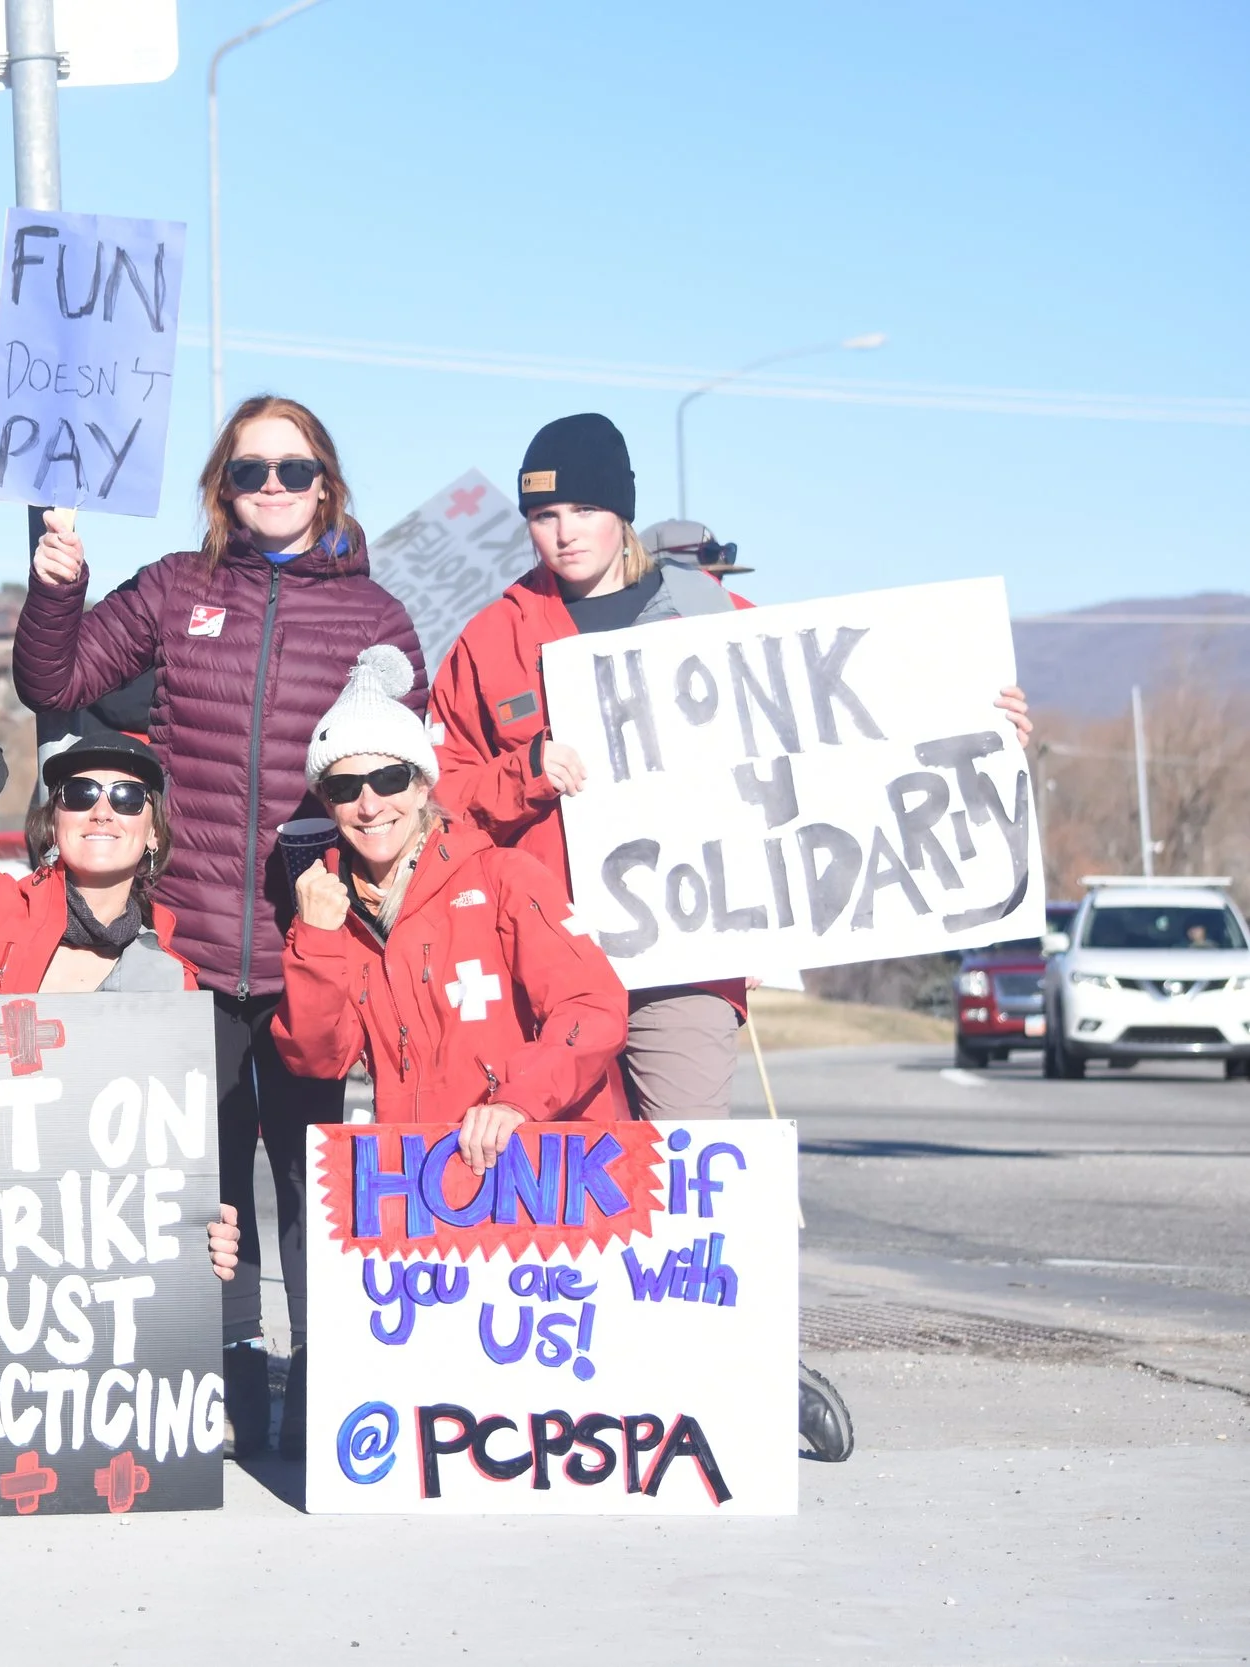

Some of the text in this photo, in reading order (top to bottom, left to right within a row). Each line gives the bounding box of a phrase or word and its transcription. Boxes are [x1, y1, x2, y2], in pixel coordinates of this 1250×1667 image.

[11, 225, 166, 333] FUN
[592, 626, 889, 784] HONK
[597, 730, 1030, 959] SOLIDARITY
[730, 755, 800, 829] 4
[88, 1068, 208, 1167] ON
[350, 1127, 748, 1239] HONK if
[362, 1231, 739, 1346] you are with
